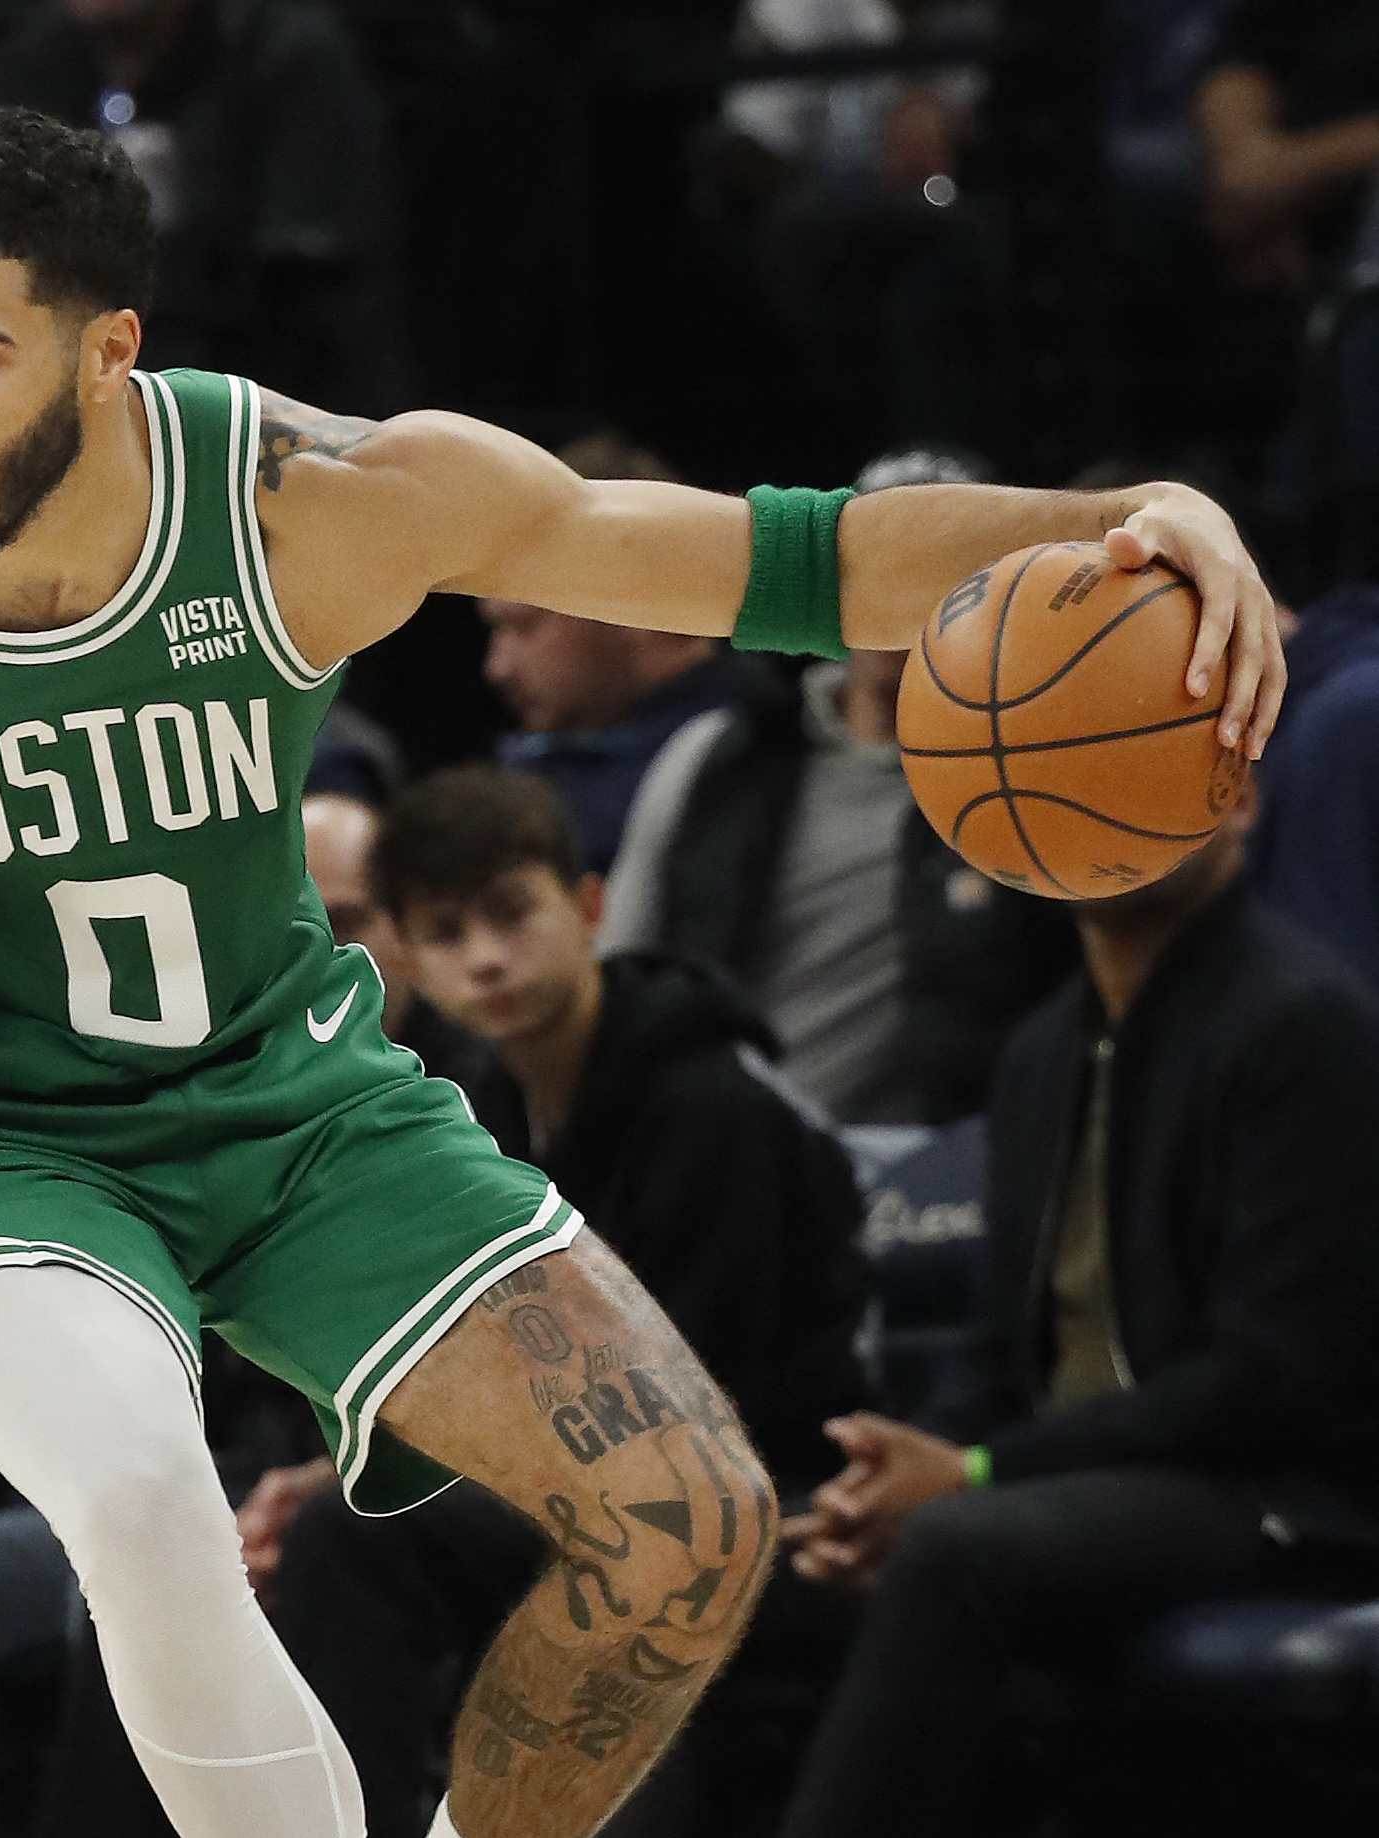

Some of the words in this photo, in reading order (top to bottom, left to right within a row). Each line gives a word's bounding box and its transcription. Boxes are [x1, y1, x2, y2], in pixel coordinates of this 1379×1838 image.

[159, 596, 245, 644] VISTA
[168, 630, 247, 670] PRINT
[45, 873, 212, 1048] 0
